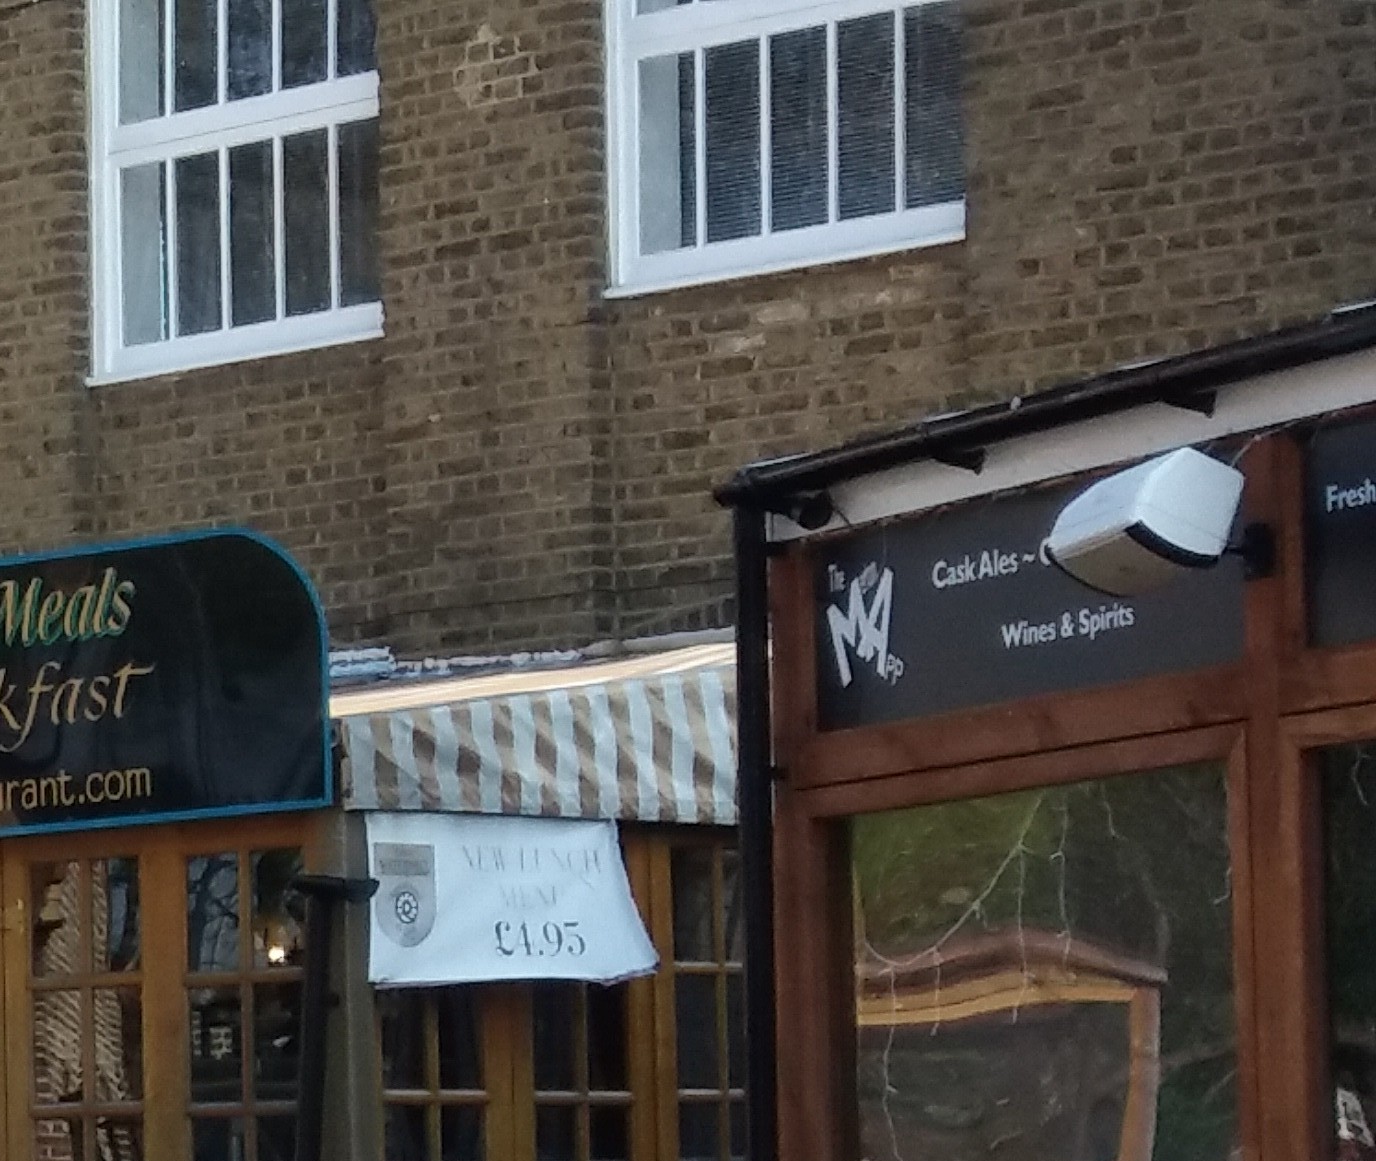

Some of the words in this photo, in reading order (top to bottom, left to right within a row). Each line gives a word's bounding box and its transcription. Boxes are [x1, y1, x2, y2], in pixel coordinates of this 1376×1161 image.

[932, 555, 977, 589] Cask
[979, 549, 1018, 581] Ales
[1001, 619, 1057, 650] Wines
[1060, 611, 1075, 639] &
[1077, 602, 1135, 641] Spirits
